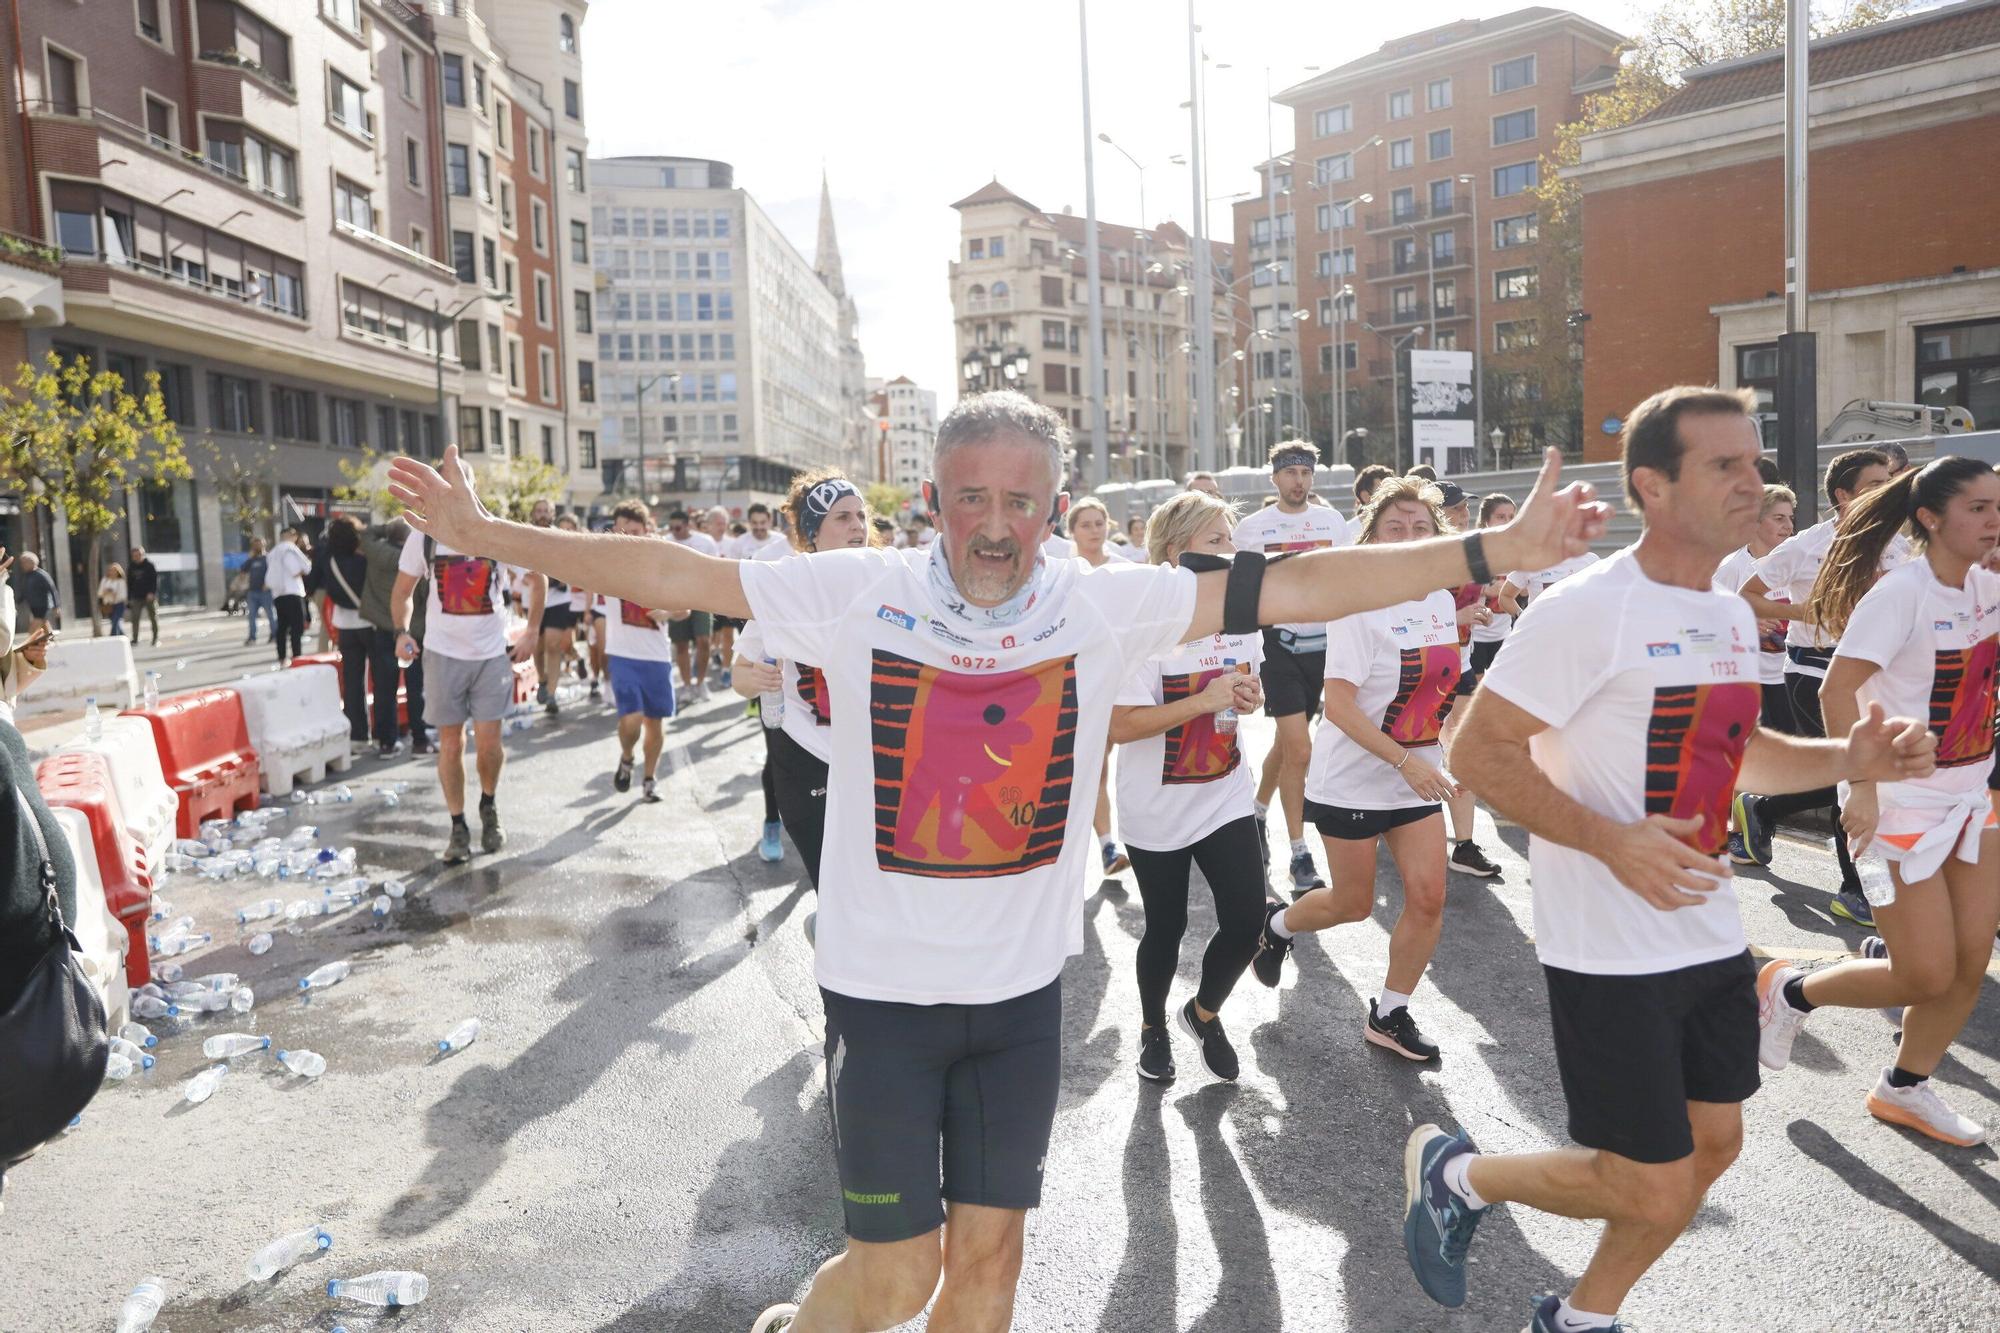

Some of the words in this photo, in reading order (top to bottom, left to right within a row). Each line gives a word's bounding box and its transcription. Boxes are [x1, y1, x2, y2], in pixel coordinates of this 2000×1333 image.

[882, 608, 907, 627] Deia
[951, 654, 997, 669] 0972
[1199, 655, 1219, 667] 1482
[1710, 660, 1739, 676] 1732
[1009, 800, 1036, 825] 10
